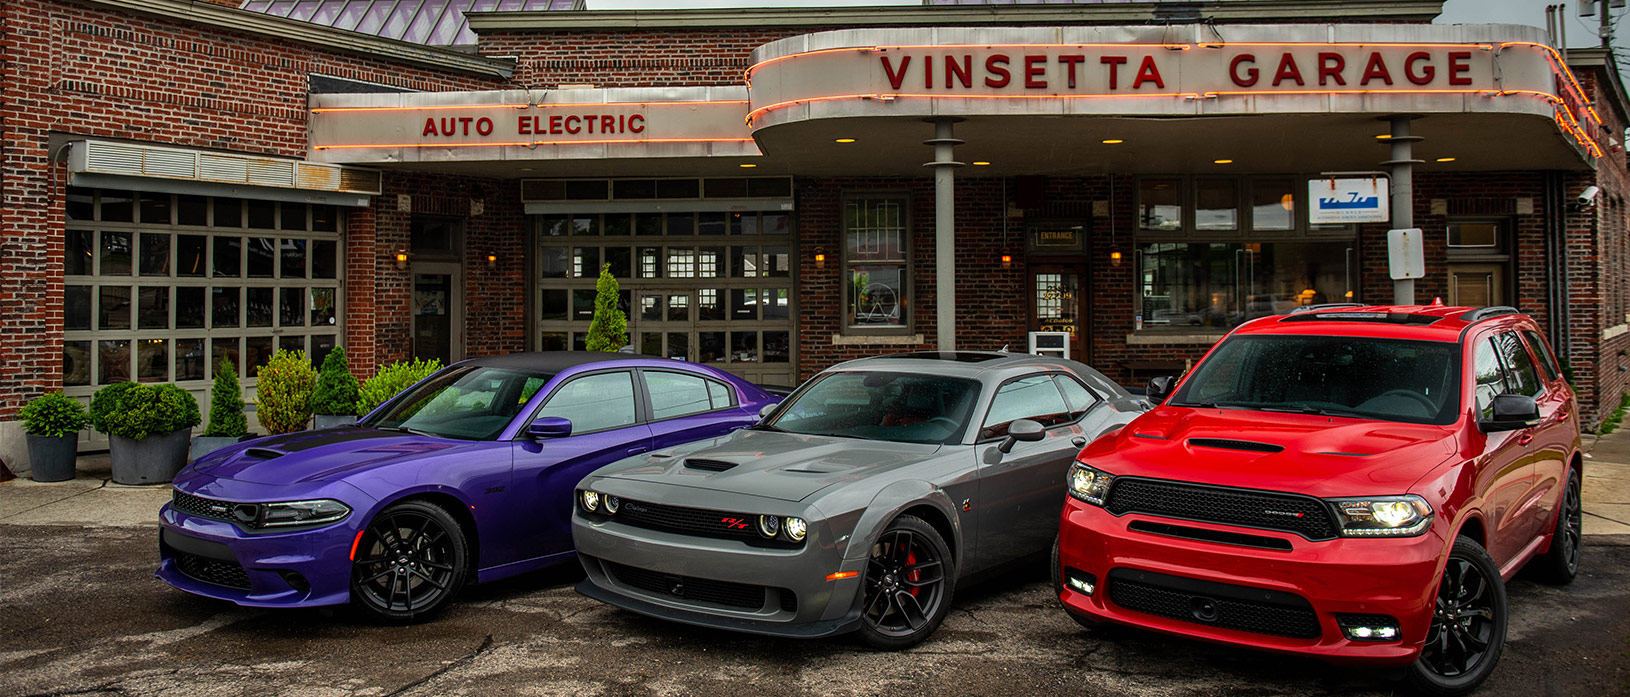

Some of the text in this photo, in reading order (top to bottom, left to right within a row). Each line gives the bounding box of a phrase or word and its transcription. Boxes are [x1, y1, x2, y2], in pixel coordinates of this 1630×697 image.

[880, 51, 1472, 90] VINSETTA GARAGE
[422, 114, 645, 136] AUTO ELECTRIC
[1041, 231, 1073, 240] ENTRANCE
[721, 518, 749, 529] R/T
